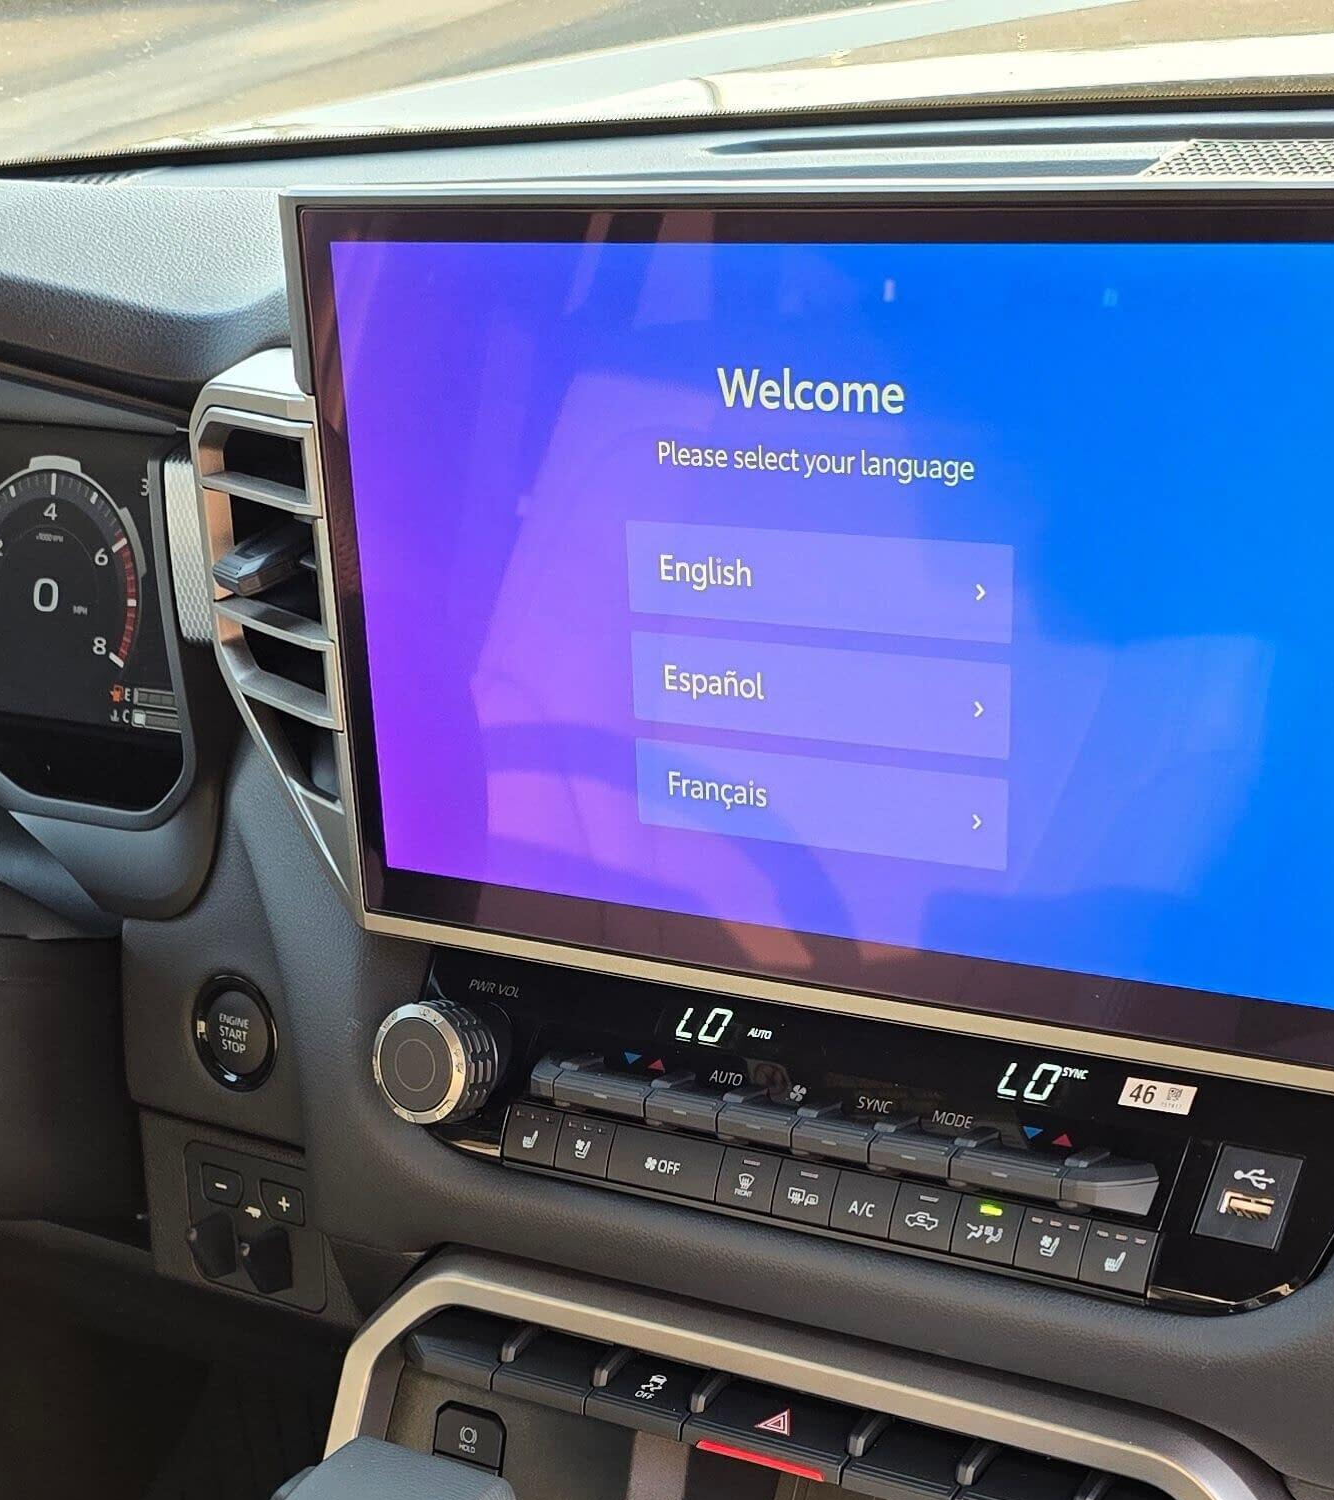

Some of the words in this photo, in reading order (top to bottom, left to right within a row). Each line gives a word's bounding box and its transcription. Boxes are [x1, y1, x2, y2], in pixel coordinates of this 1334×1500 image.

[717, 367, 905, 415] Welcome
[657, 441, 728, 469] Please
[734, 446, 799, 473] select
[804, 452, 855, 478] your
[861, 450, 975, 486] language
[43, 503, 58, 520] 4
[94, 548, 108, 566] 6
[659, 554, 752, 591] English
[33, 577, 59, 612] 0
[73, 605, 88, 616] MPH
[92, 636, 107, 655] 8
[663, 664, 764, 701] Español
[668, 770, 768, 810] Français
[469, 978, 496, 995] PWR
[497, 982, 521, 998] VOL
[219, 1013, 249, 1029] ENGINE
[675, 1007, 733, 1044] LO
[219, 1025, 248, 1042] START
[748, 1027, 772, 1040] AUTO
[222, 1039, 246, 1054] STOP
[708, 1068, 743, 1087] AUTO
[996, 1061, 1063, 1102] LO
[1062, 1066, 1089, 1081] SYNC
[1129, 1083, 1157, 1105] 46
[855, 1095, 893, 1115] SYNC
[932, 1109, 974, 1129] MODE
[658, 1160, 681, 1176] OFF
[734, 1187, 753, 1198] FRONT
[848, 1200, 875, 1219] A/C
[635, 1390, 655, 1400] OFF
[458, 1443, 476, 1454] HOLD
